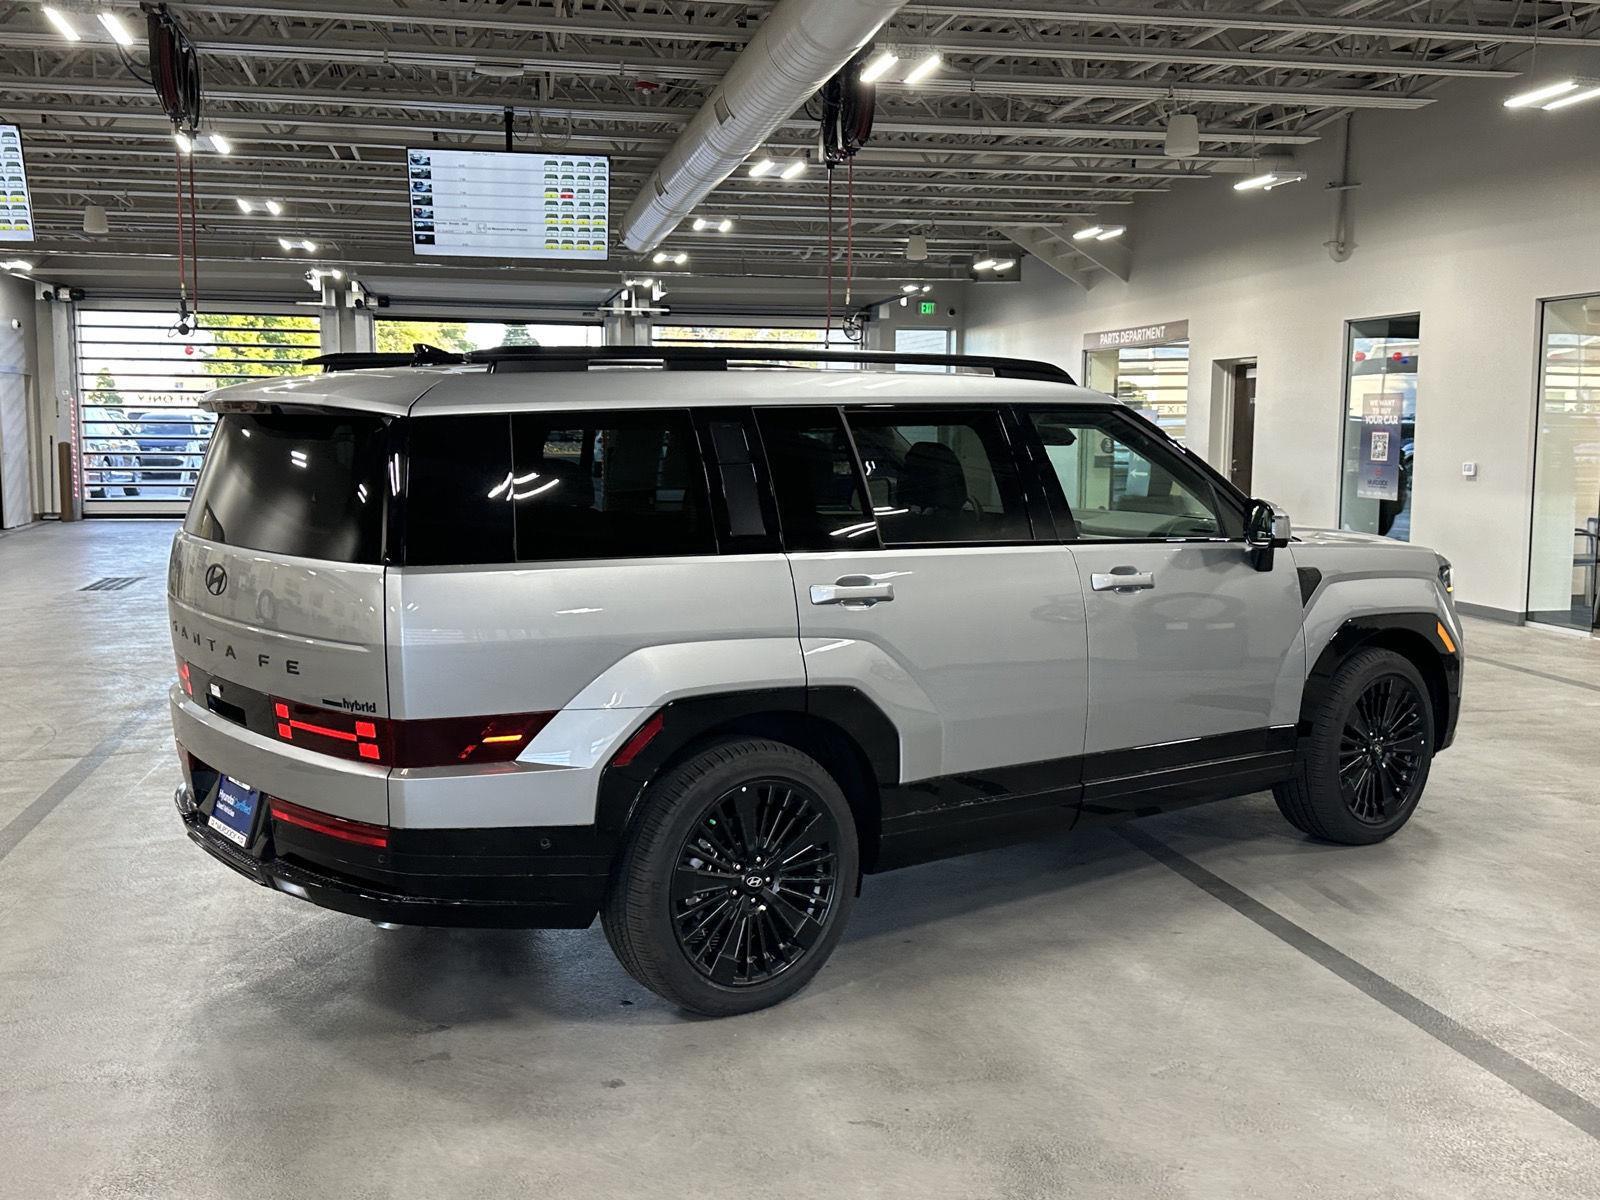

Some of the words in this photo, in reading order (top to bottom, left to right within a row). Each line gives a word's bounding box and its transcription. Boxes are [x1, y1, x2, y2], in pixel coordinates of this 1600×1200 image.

[921, 303, 935, 314] EXIT
[1099, 332, 1120, 345] PARTS
[1120, 326, 1166, 343] DEPARTMENT
[1369, 399, 1379, 407] WE
[1380, 399, 1395, 407] WANT
[1372, 407, 1380, 415] TO
[1365, 415, 1383, 425] YOUR
[1384, 415, 1399, 425] CAR
[258, 653, 300, 675] FE
[342, 697, 376, 713] hybrid
